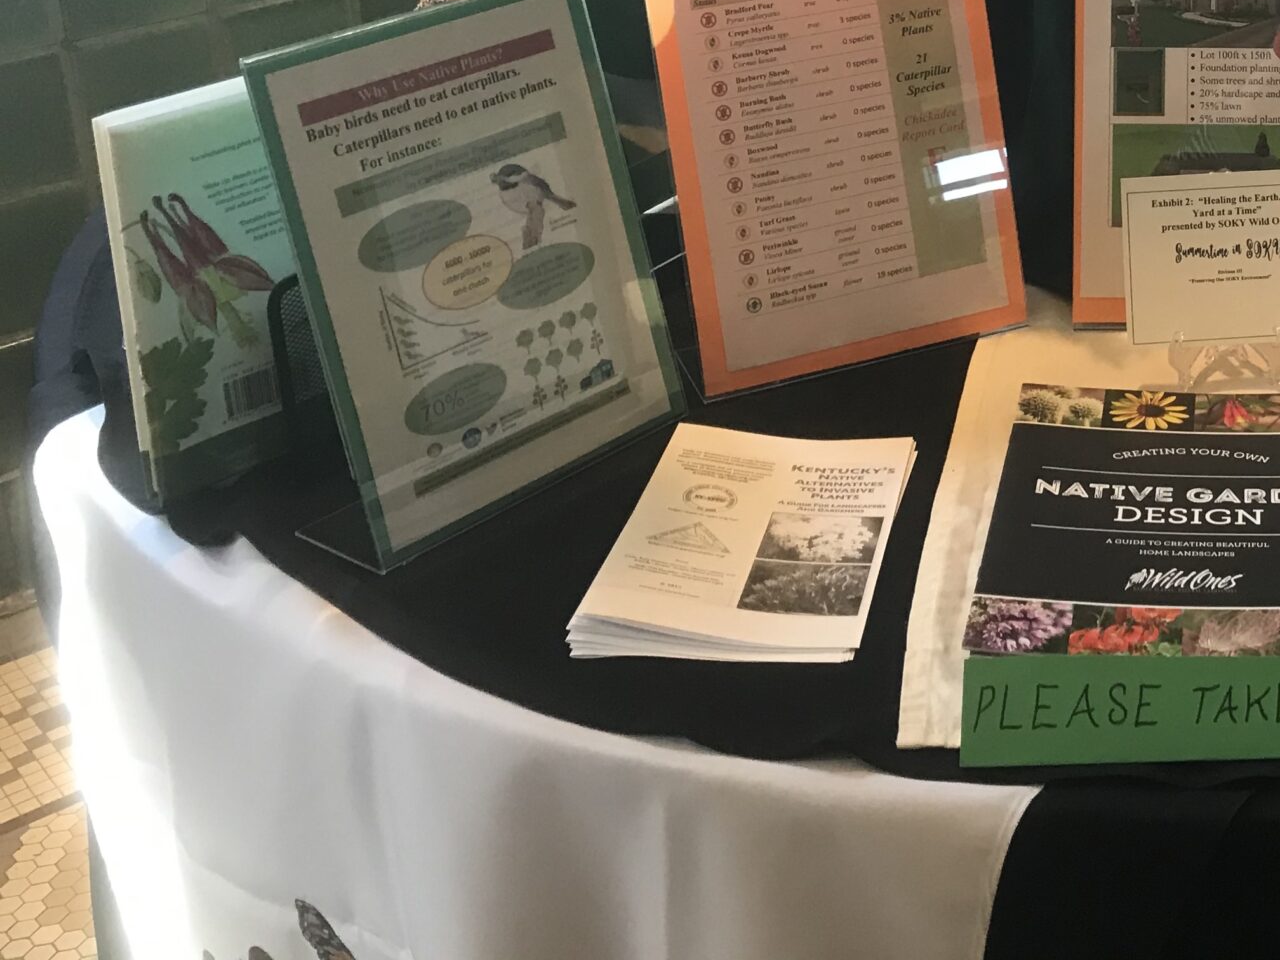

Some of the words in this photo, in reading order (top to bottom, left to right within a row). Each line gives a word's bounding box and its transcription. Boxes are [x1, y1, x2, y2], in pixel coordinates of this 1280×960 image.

[888, 11, 905, 24] 3%
[908, 6, 941, 20] Native
[901, 24, 933, 37] Plants
[915, 52, 927, 64] 21
[1199, 50, 1214, 59] Lot
[1218, 50, 1239, 59] 100ft
[1240, 52, 1247, 60] x
[1250, 50, 1271, 60] 150ft
[357, 85, 390, 104] Why
[391, 77, 414, 91] Use
[417, 64, 457, 81] Native
[459, 47, 502, 71] Plants?
[895, 64, 951, 82] Caterpillar
[905, 80, 945, 96] Species
[1199, 88, 1219, 97] 20%
[1220, 88, 1263, 100] hardscape
[1265, 89, 1280, 98] and
[305, 123, 340, 142] Baby
[343, 110, 378, 130] birds
[381, 98, 411, 118] need
[412, 96, 426, 107] to
[429, 88, 448, 102] eat
[450, 68, 520, 96] caterpillars.
[1199, 101, 1219, 110] 75%
[1220, 101, 1241, 110] lawn
[332, 124, 411, 156] Caterpillars
[413, 111, 443, 131] need
[444, 109, 457, 120] to
[460, 101, 478, 115] eat
[481, 90, 516, 109] native
[518, 78, 557, 99] plants.
[359, 156, 383, 172] For
[385, 137, 441, 163] instance:
[1151, 198, 1183, 207] Exhibit
[1185, 197, 1193, 205] 2:
[1198, 195, 1236, 205] “Healing
[1238, 194, 1252, 203] the
[1254, 192, 1280, 202] Earth,
[1192, 208, 1214, 217] Yard
[1216, 208, 1225, 216] at
[1234, 205, 1261, 215] Time”
[1161, 220, 1203, 233] presented
[1205, 220, 1215, 230] by
[1217, 218, 1244, 227] SOKY
[1248, 217, 1269, 225] Wild
[1174, 242, 1228, 263] Summertime
[1231, 243, 1241, 254] in
[1112, 448, 1187, 460] CREATING
[1190, 448, 1230, 457] YOUR
[1233, 451, 1270, 464] OWN
[791, 464, 896, 474] KENTUCKY'S
[794, 479, 884, 487] ALTERNATIVES
[1035, 478, 1174, 503] NATIVE
[1114, 506, 1264, 525] DESIGN
[973, 682, 1162, 732] PLEASE
